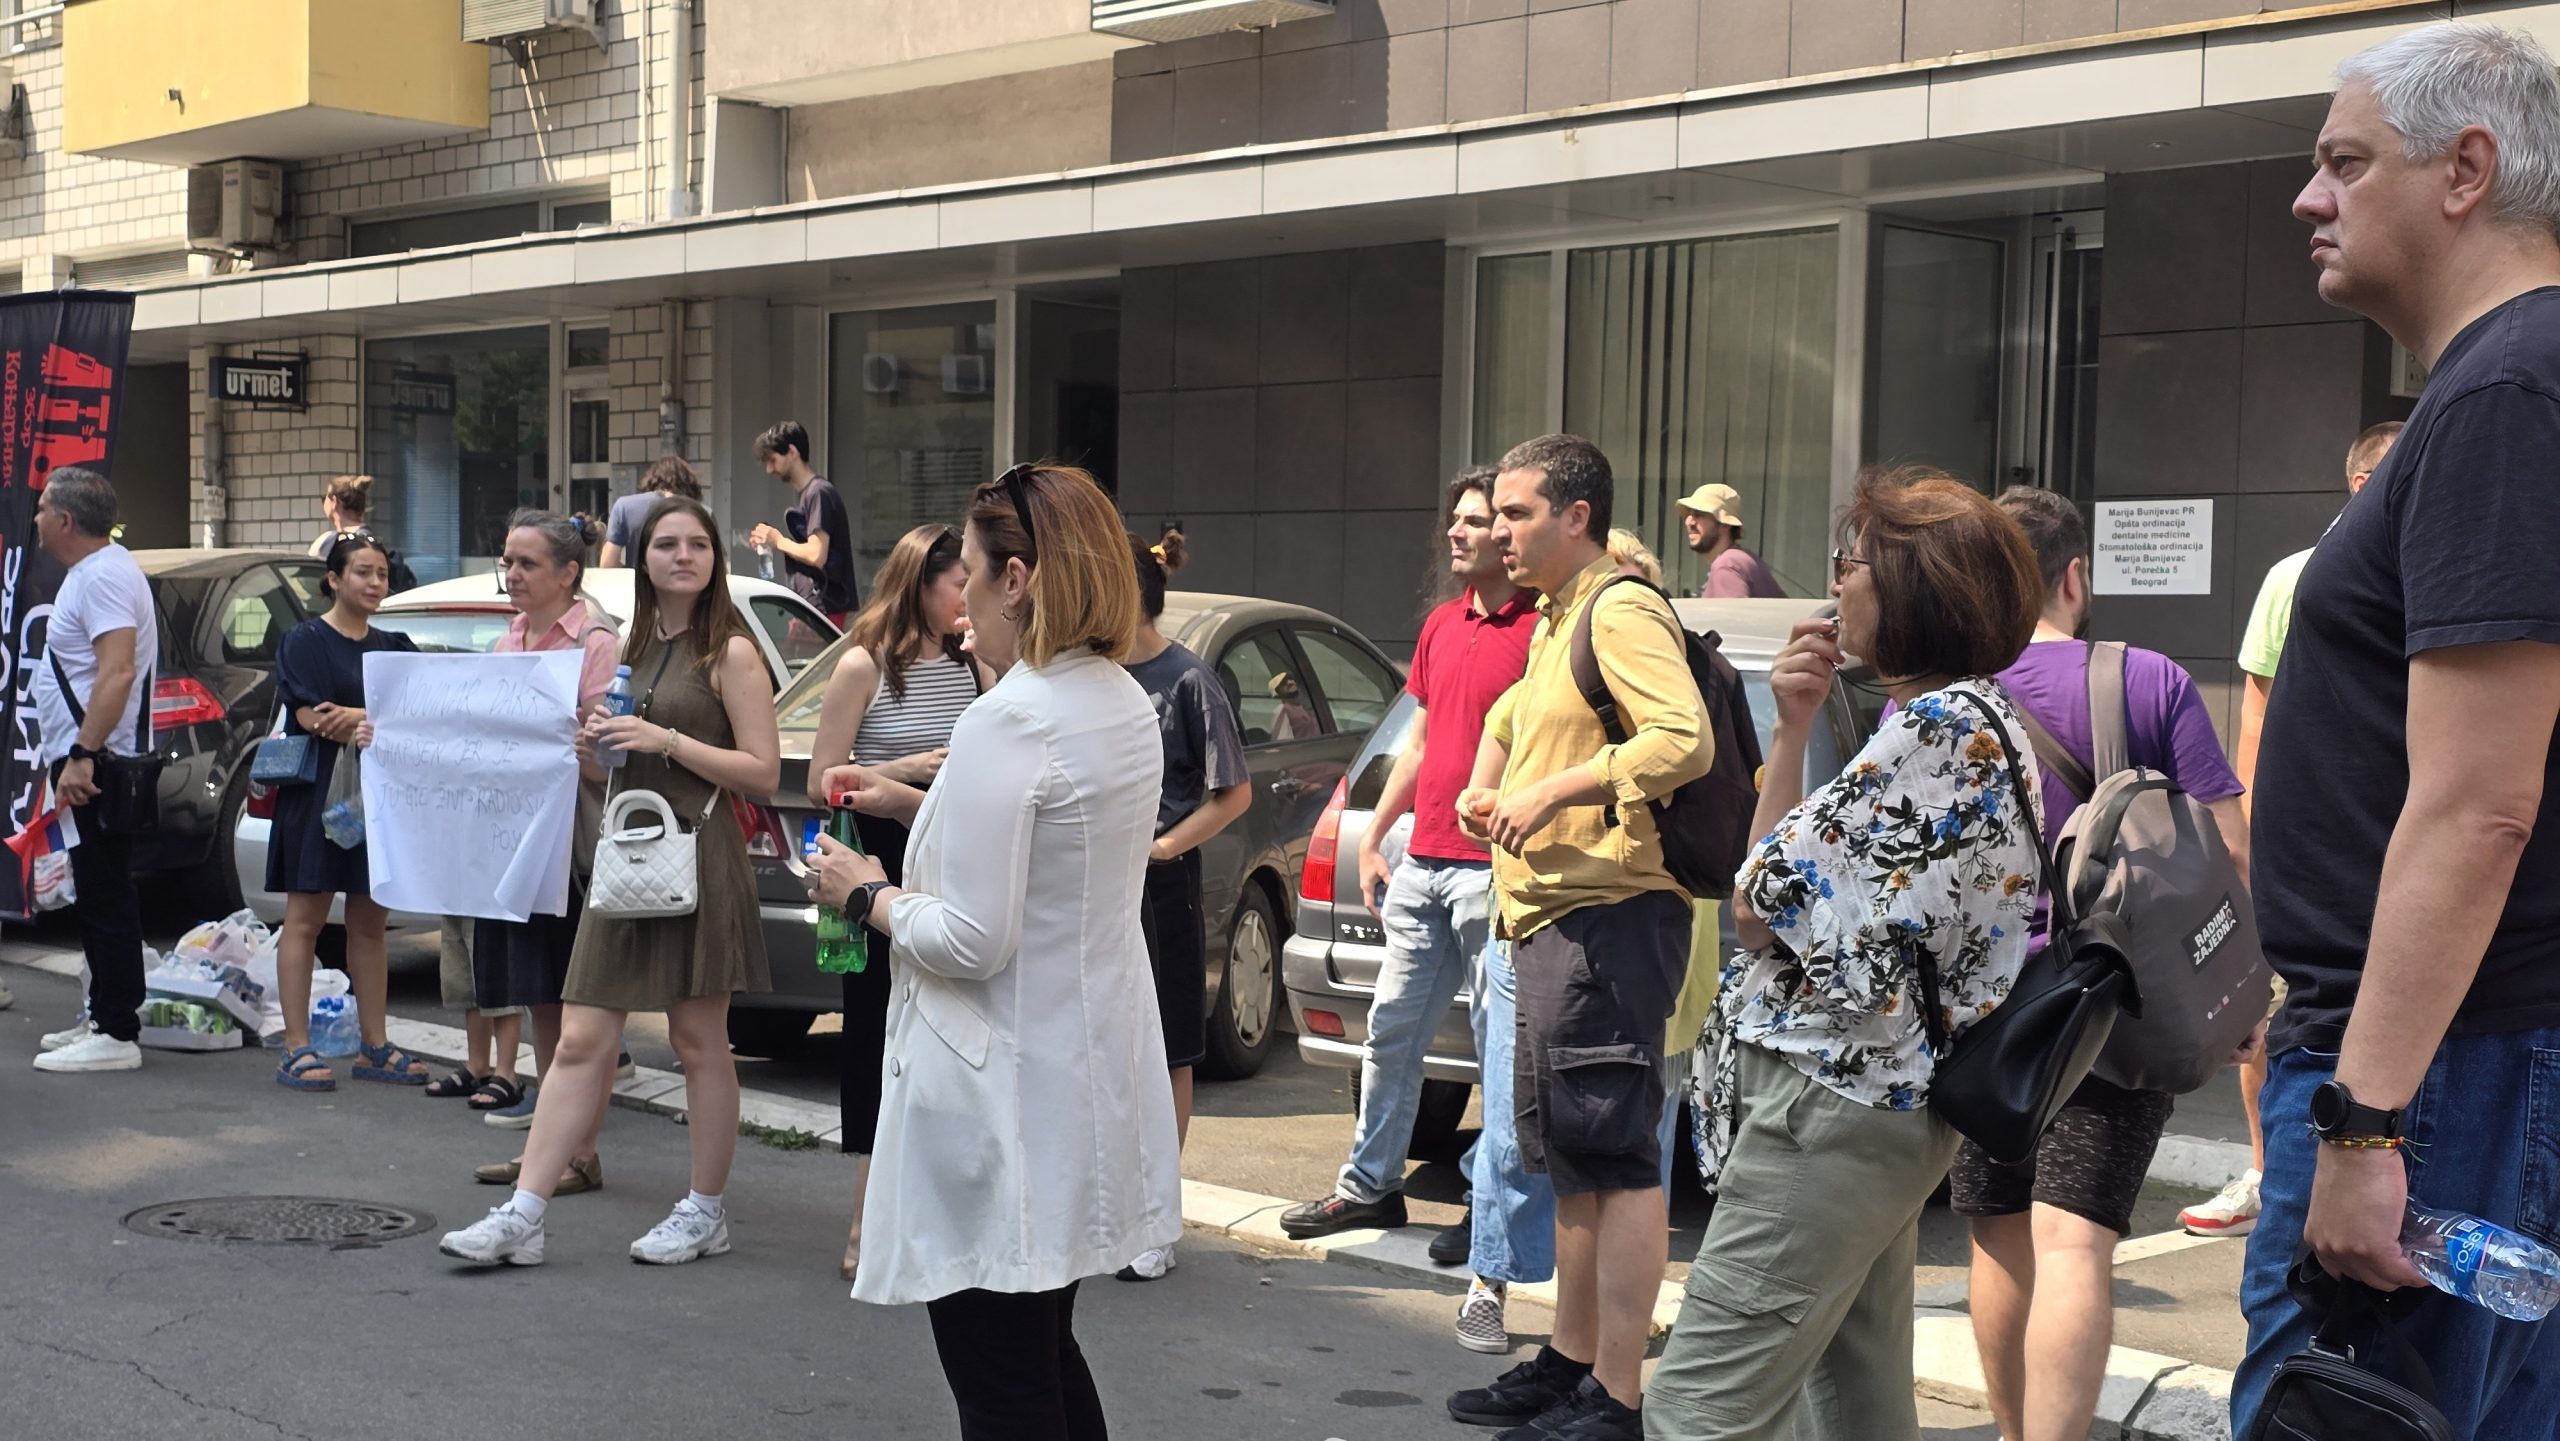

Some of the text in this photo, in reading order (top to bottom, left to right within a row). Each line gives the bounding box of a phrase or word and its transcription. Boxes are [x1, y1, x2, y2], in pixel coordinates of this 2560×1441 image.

[226, 366, 293, 398] urmet
[21, 387, 36, 449] Збор
[2108, 506, 2195, 518] Marija Bunijevac PR
[2114, 519, 2186, 529] Opšta ordinacija
[2112, 531, 2190, 540] dentalne medicine
[2098, 542, 2204, 552] Stomatološka ordinacija
[2114, 554, 2187, 564] Marija Bunijevac
[2121, 565, 2178, 574] ul. Porečka 5
[2131, 577, 2168, 587] Beograd
[492, 739, 520, 766] JE
[475, 784, 522, 817] RADIO
[2455, 1231, 2484, 1273] rosa
